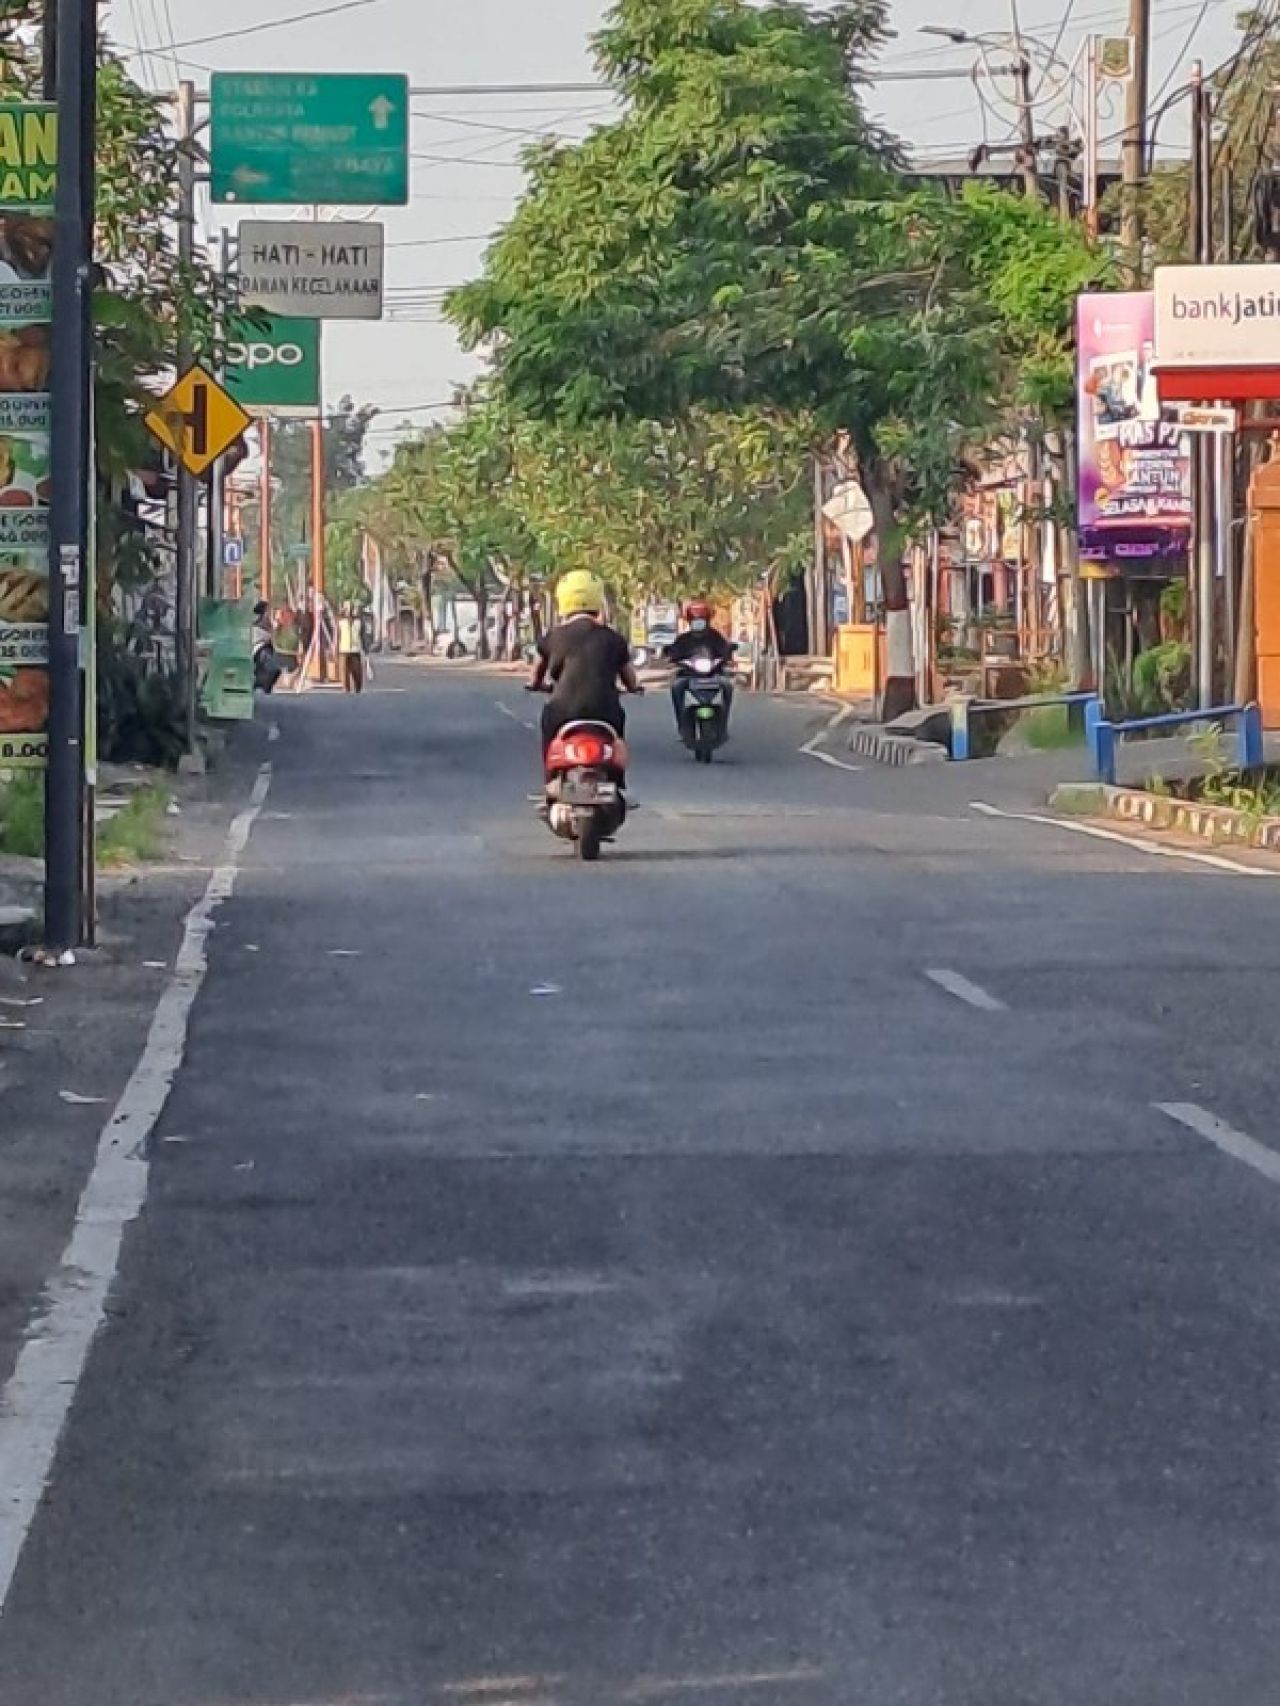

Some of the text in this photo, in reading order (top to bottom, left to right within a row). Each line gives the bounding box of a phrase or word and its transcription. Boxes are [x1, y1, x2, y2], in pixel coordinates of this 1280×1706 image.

[253, 244, 300, 265] HATI
[321, 244, 368, 266] HATI
[1172, 292, 1280, 325] bankjati
